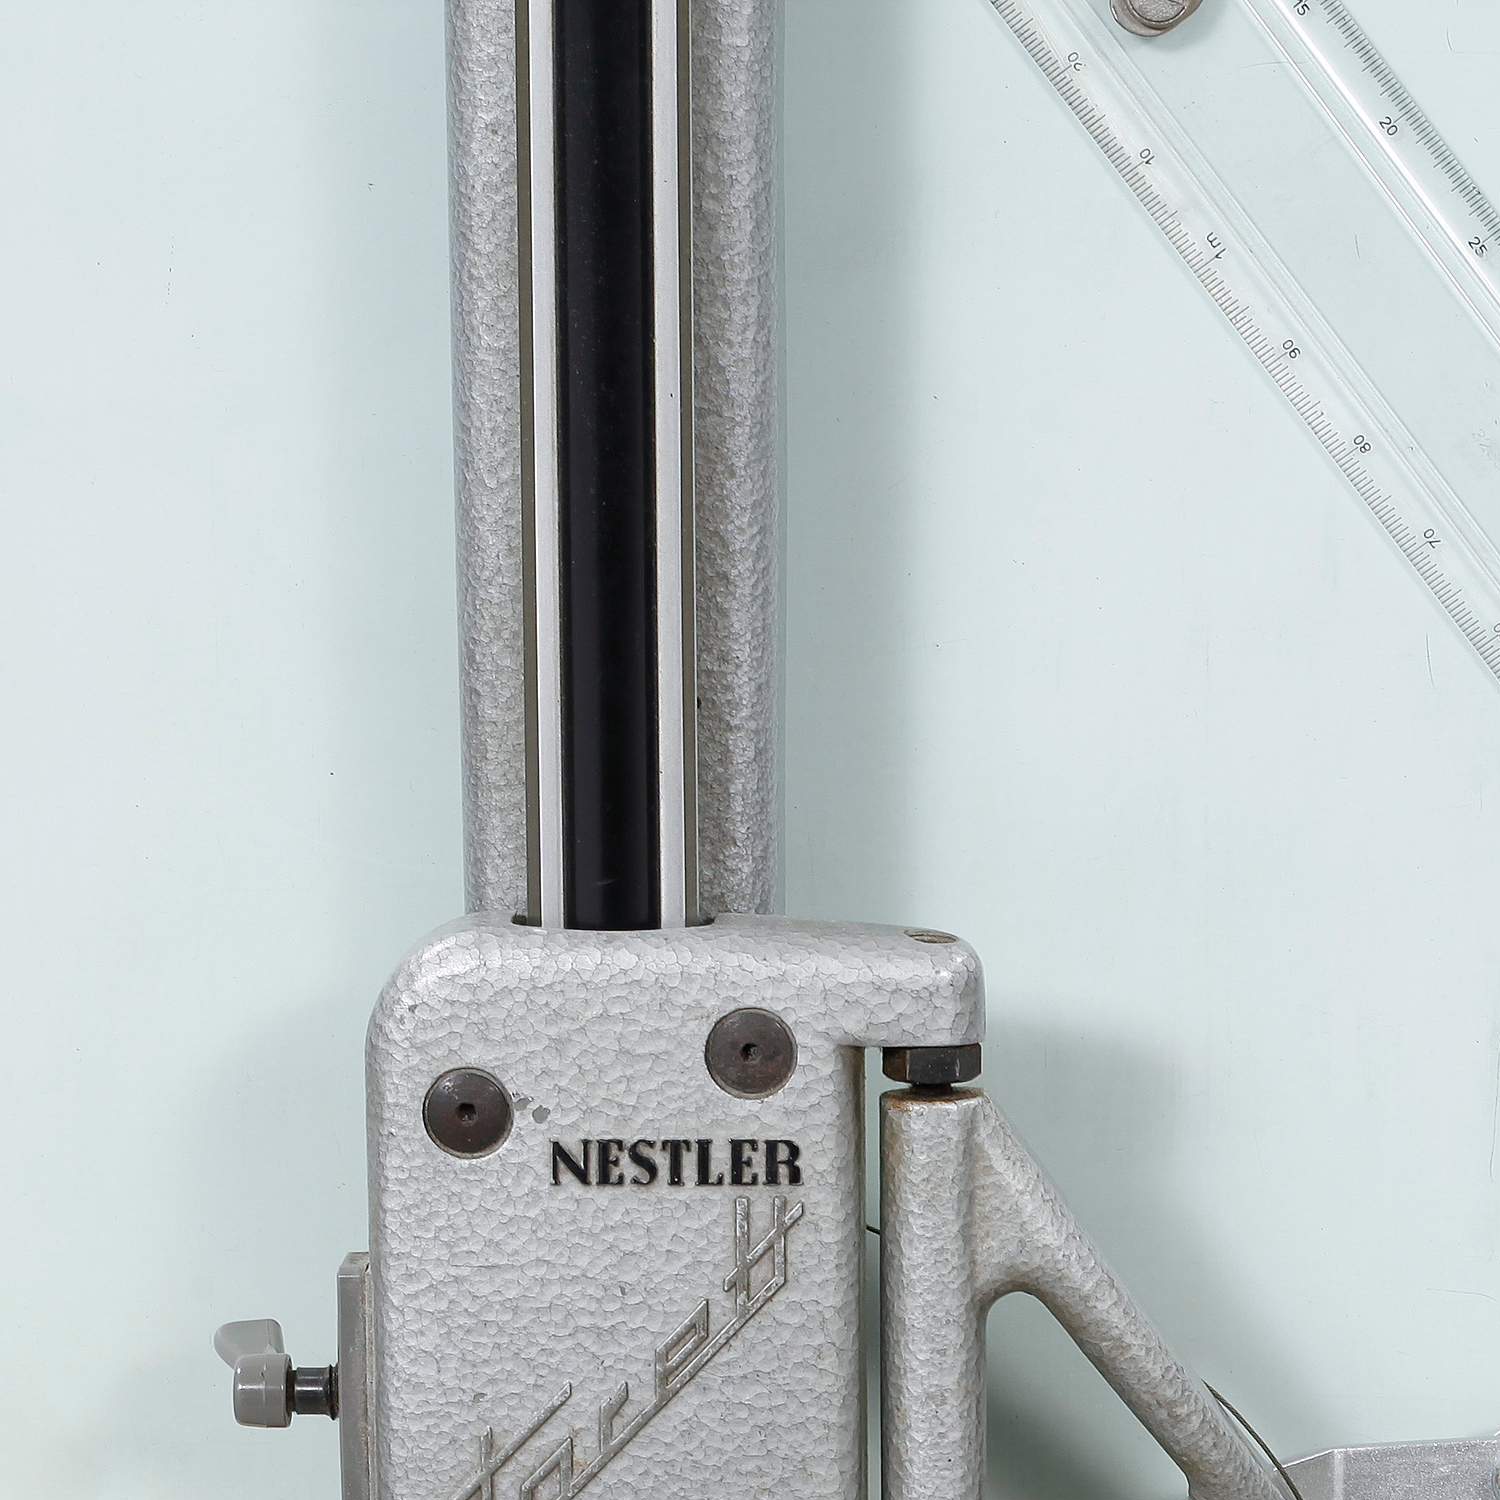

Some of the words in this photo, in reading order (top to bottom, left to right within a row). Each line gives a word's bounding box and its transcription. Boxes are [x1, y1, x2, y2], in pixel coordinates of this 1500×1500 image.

[1293, 0, 1310, 16] 15
[1379, 115, 1398, 137] 20
[1139, 148, 1155, 167] 10
[1206, 231, 1228, 260] 1m
[1467, 235, 1488, 258] 25
[1282, 339, 1302, 360] 90
[1352, 434, 1372, 455] 80
[1423, 527, 1441, 549] 70
[549, 1138, 804, 1187] NESTLER
